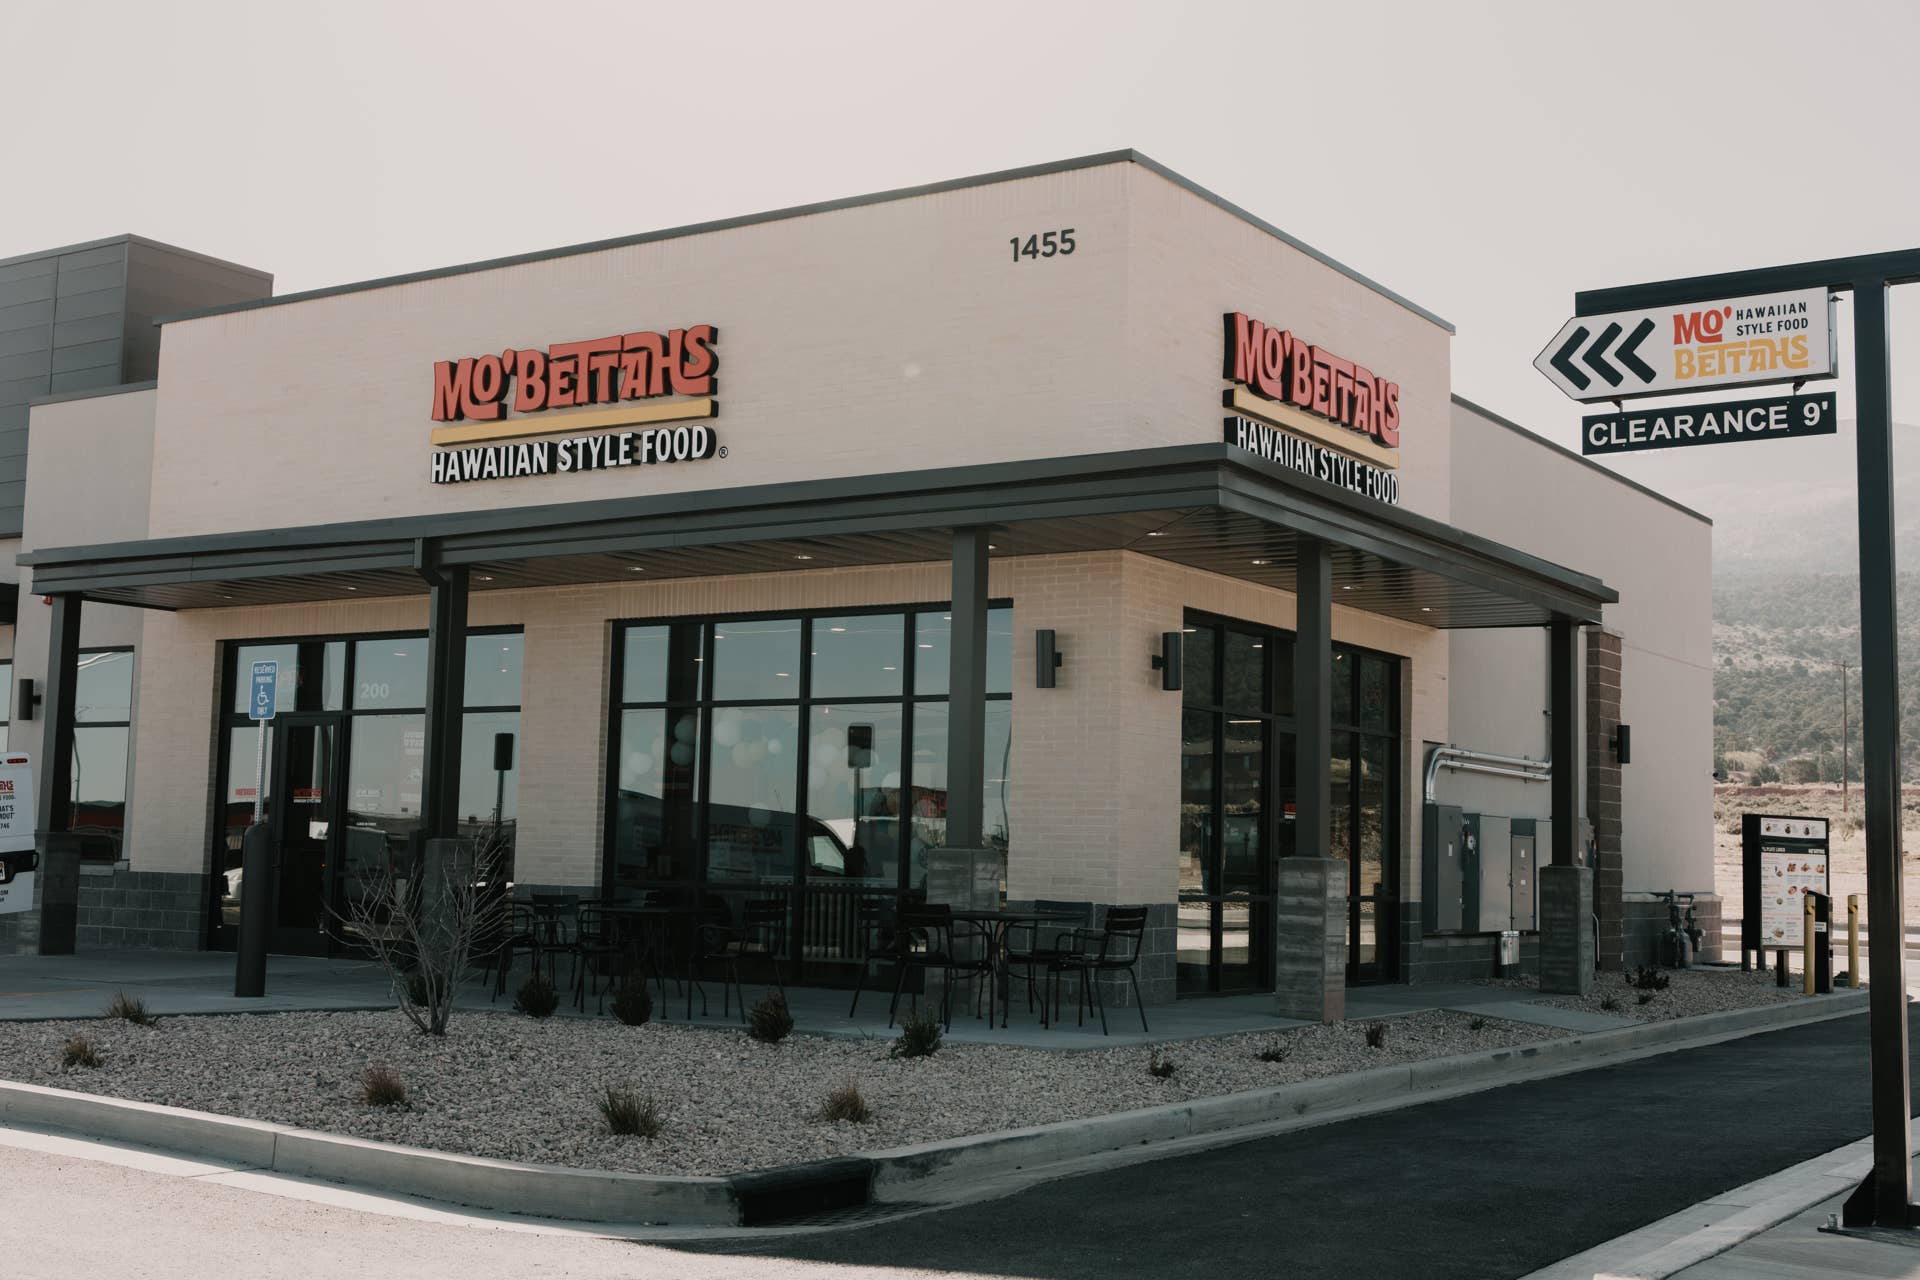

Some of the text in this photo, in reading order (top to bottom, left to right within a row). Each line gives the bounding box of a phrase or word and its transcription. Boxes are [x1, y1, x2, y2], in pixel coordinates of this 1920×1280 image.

[1009, 228, 1076, 262] 1455
[1735, 301, 1808, 321] HAWAIIAN
[1736, 317, 1809, 336] STYLE FOOD
[1674, 334, 1809, 380] BETTAHS
[1588, 405, 1788, 447] CLEARANCE
[431, 441, 552, 484] HAWAIIAN
[557, 432, 639, 472] STYLE
[642, 425, 715, 463] FOOD
[1235, 416, 1400, 505] HAWAIIAN STYLE FOOD
[360, 682, 390, 699] 200
